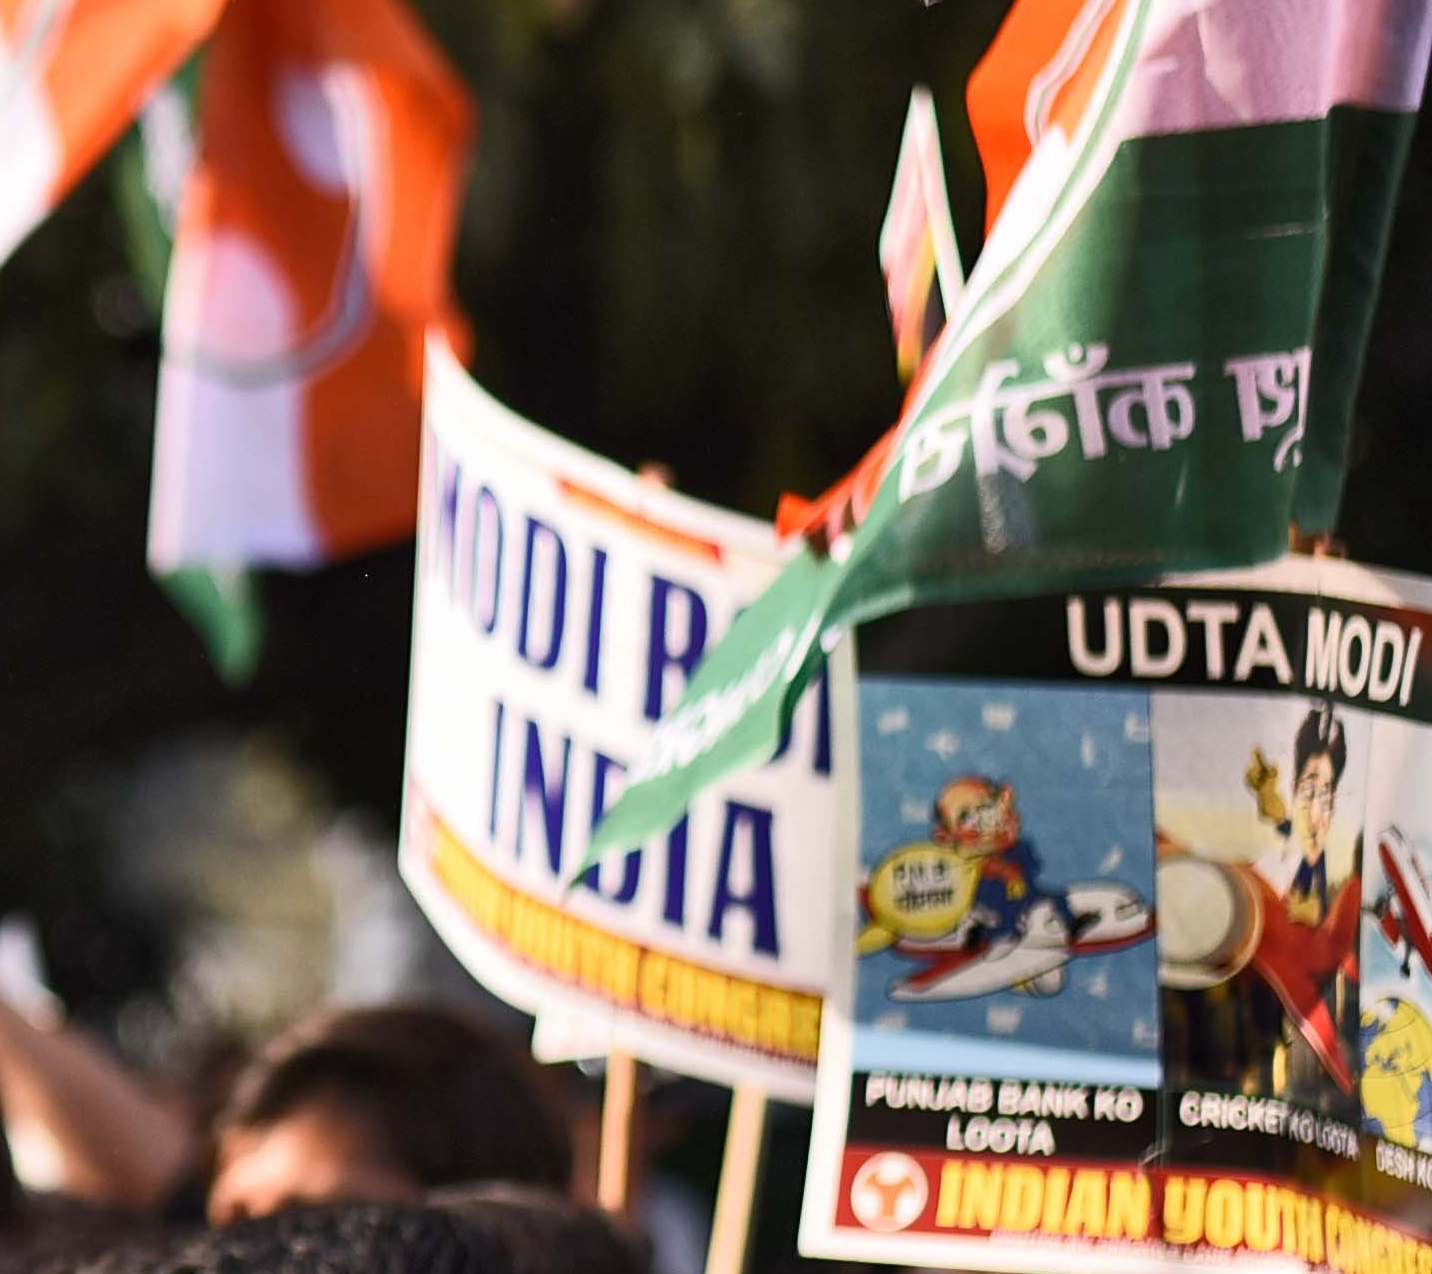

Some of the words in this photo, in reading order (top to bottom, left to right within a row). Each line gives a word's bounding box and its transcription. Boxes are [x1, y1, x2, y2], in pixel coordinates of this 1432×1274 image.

[1066, 594, 1294, 685] UDTA
[1305, 606, 1423, 707] MODI
[490, 700, 780, 961] INDIA
[865, 1071, 994, 1113] PUNJAB
[997, 1079, 1089, 1120] BANK
[1093, 1086, 1144, 1123] KO
[945, 1115, 1056, 1157] LOOTA
[1179, 1090, 1289, 1137] CRICKET
[934, 1157, 1152, 1242] INDIAN
[1163, 1175, 1325, 1265] YOUTH
